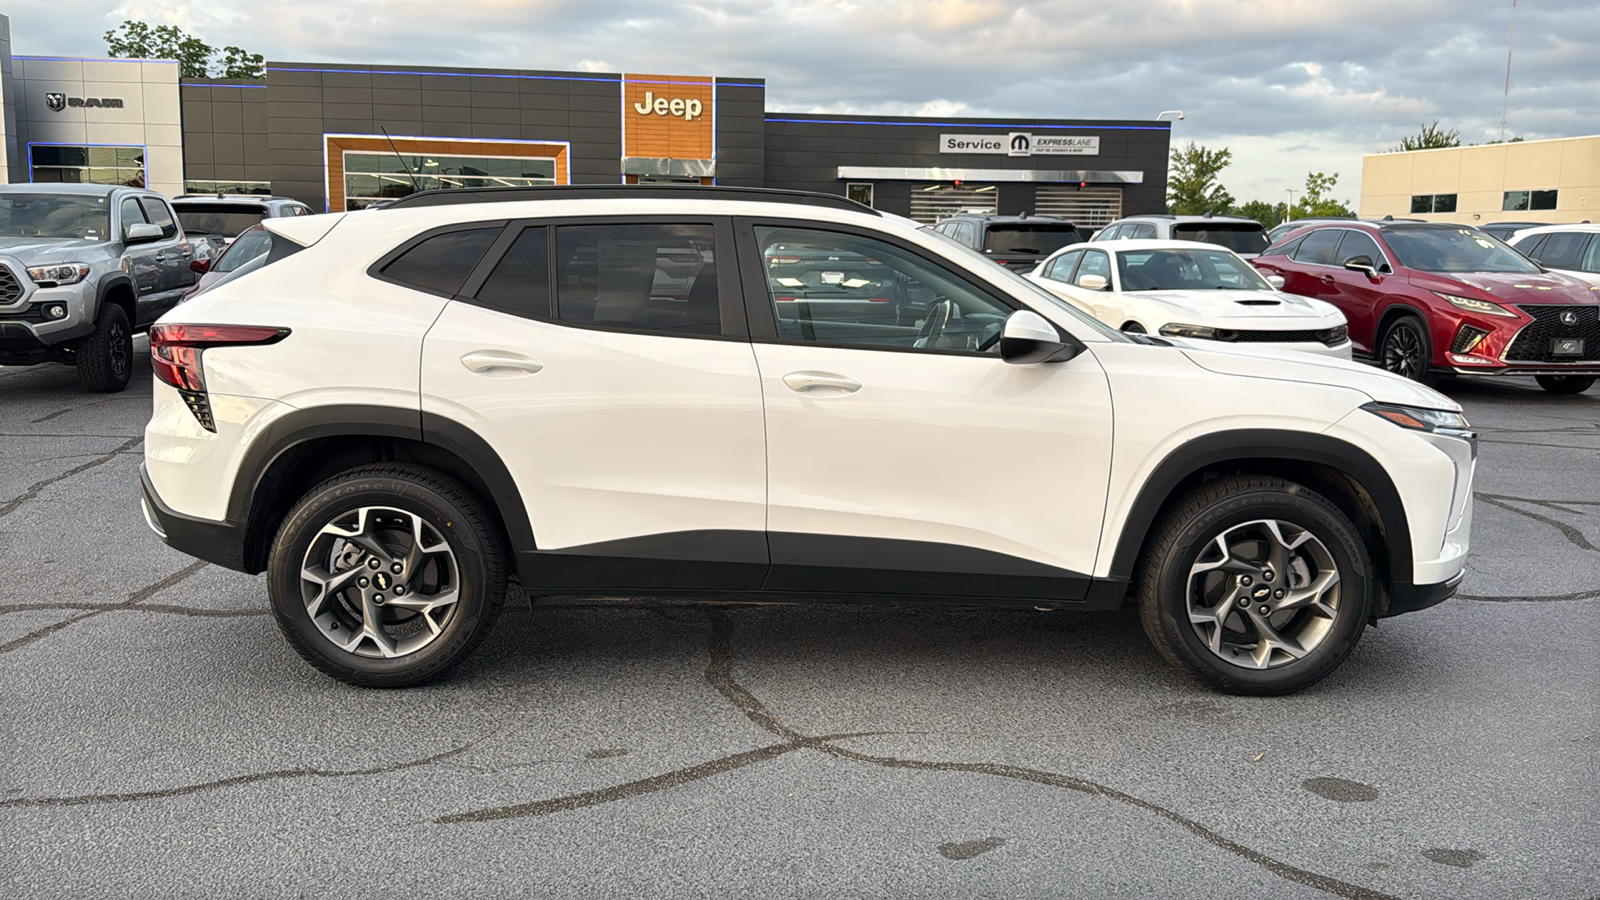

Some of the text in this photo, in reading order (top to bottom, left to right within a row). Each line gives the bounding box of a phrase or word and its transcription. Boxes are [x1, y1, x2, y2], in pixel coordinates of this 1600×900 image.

[67, 97, 124, 109] RAM
[634, 91, 703, 121] Jeep
[947, 138, 1002, 150] Service
[1036, 138, 1093, 147] EXPRESSLANE
